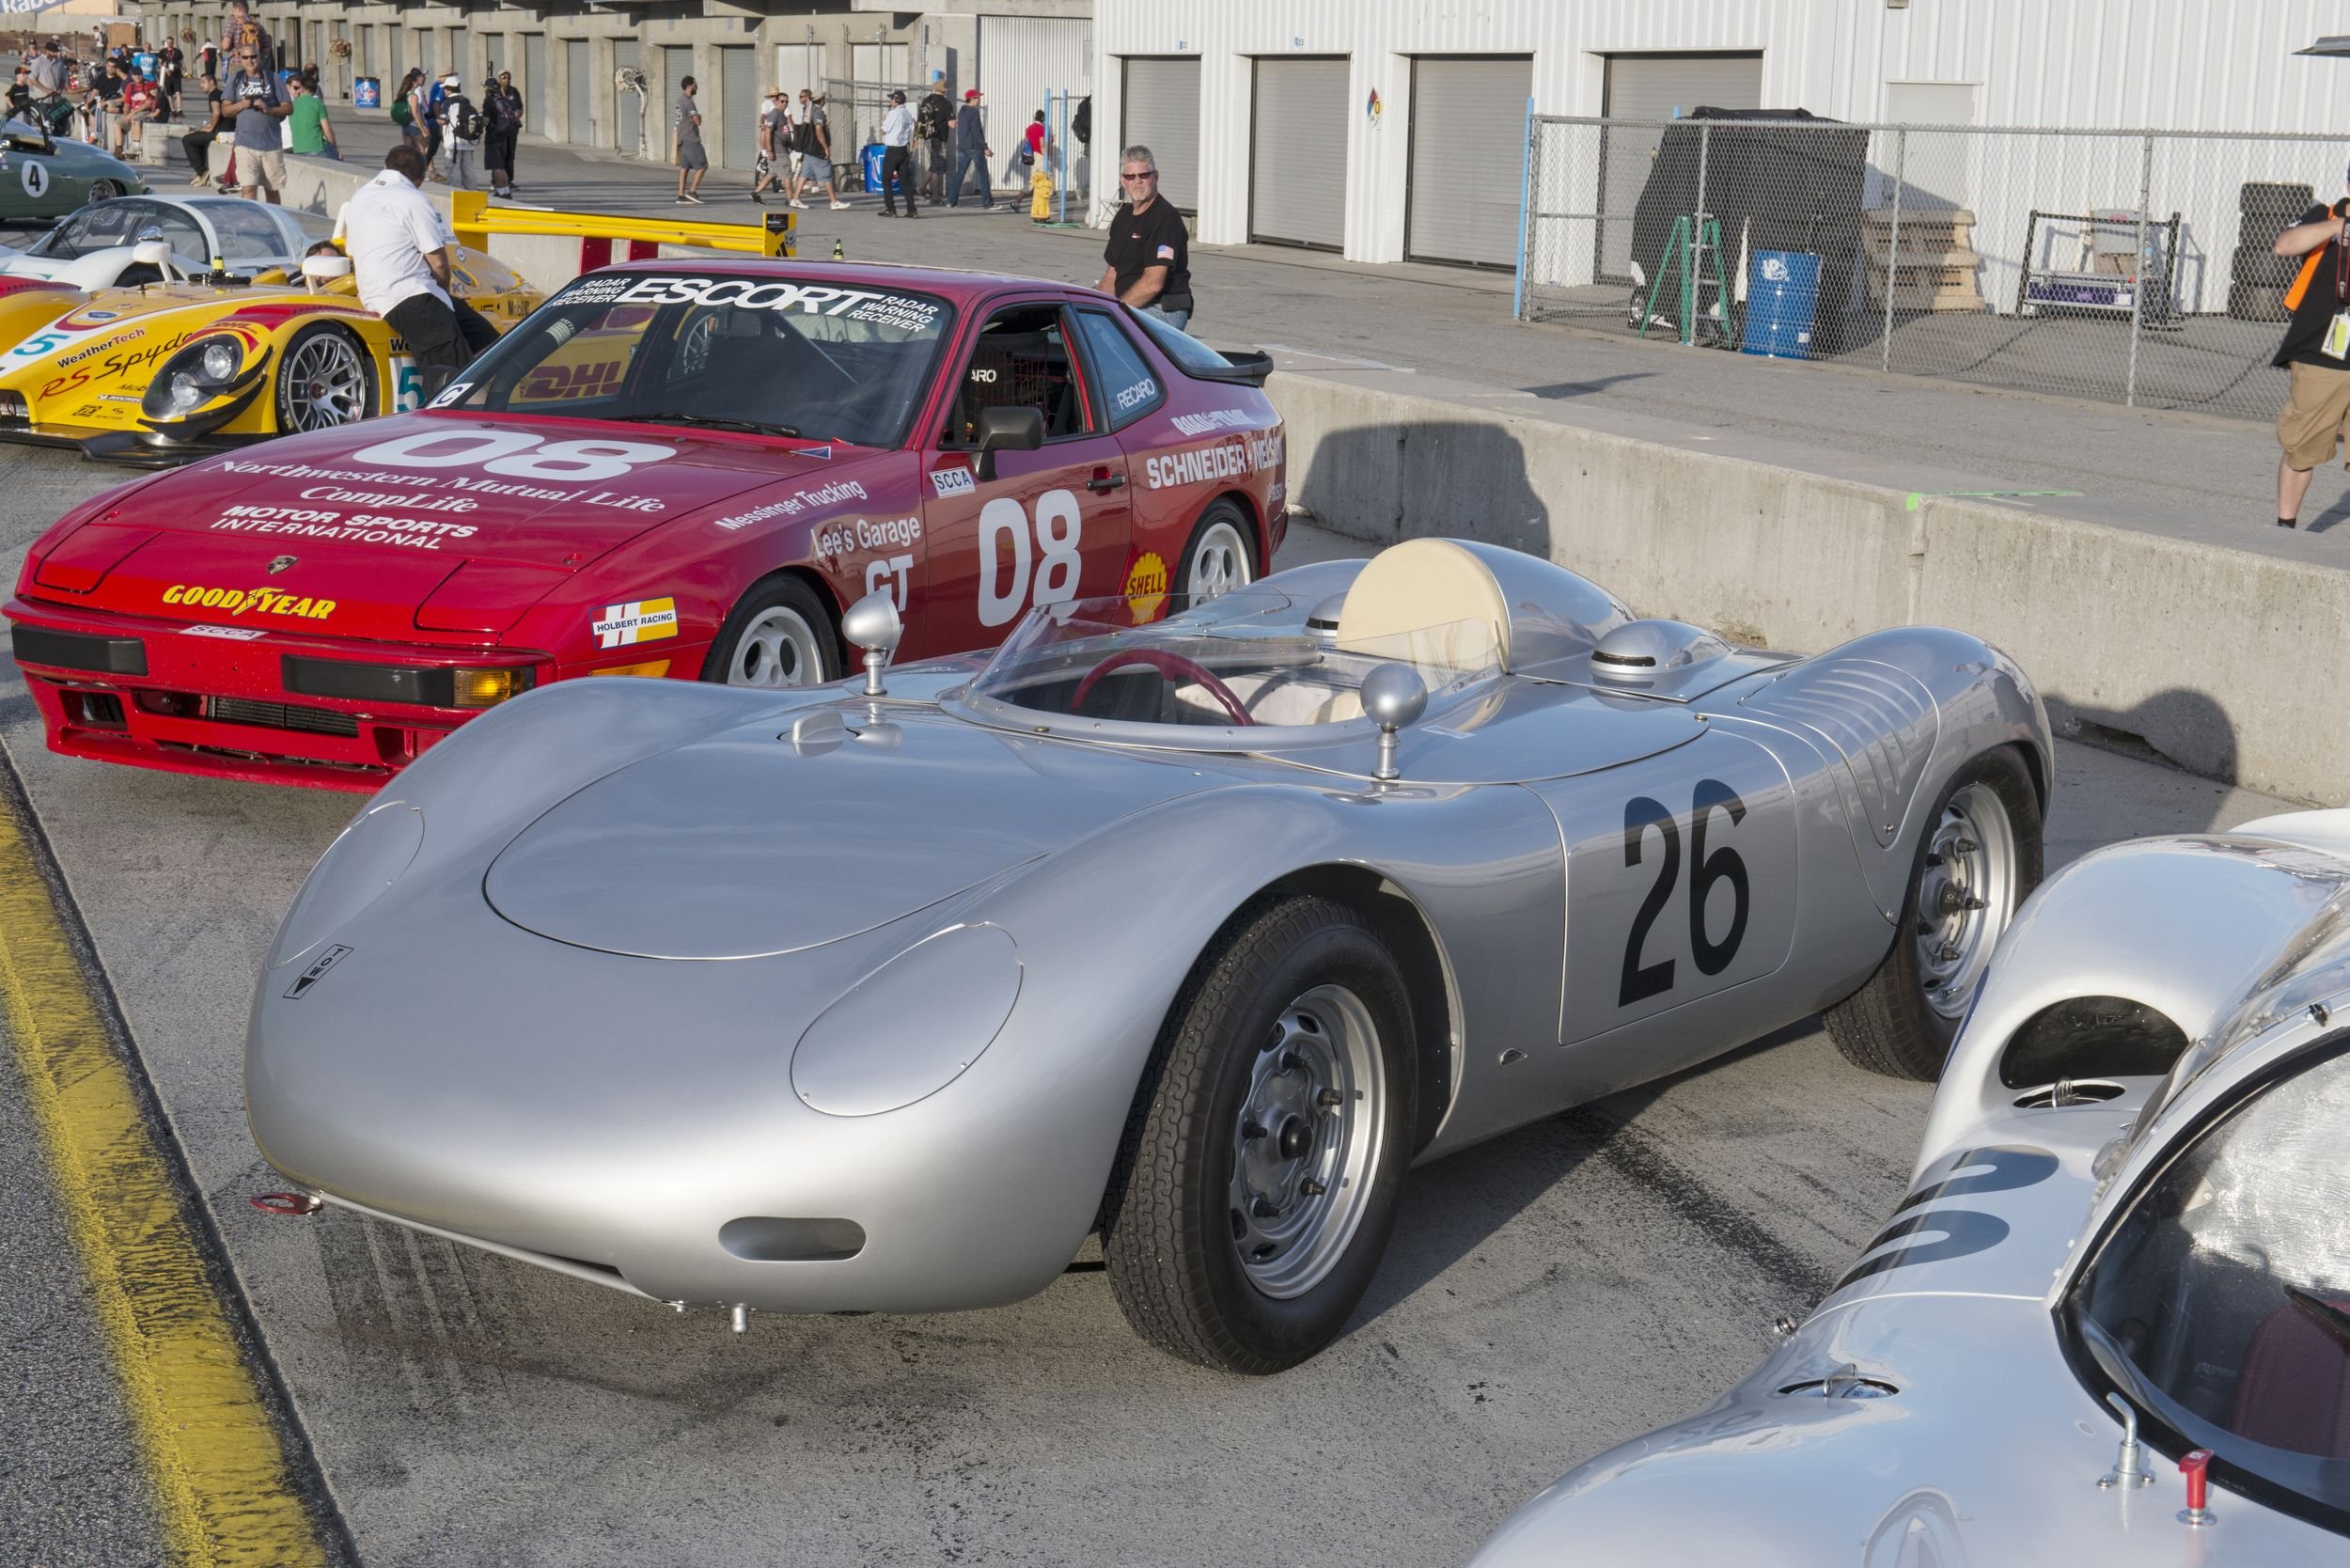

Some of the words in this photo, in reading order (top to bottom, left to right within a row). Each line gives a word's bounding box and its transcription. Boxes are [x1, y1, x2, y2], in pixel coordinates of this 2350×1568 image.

[28, 165, 40, 192] 4
[560, 286, 626, 299] WARNING
[580, 277, 632, 290] RADAR
[612, 277, 886, 317] ESCORT
[547, 294, 617, 308] RECEIVER
[860, 302, 933, 323] WARNING
[881, 296, 939, 315] RADAR
[846, 309, 926, 332] RECEIVER
[13, 333, 71, 356] 5
[56, 328, 146, 368] WeatherTech
[37, 366, 91, 402] RS
[398, 366, 426, 412] 5
[520, 361, 623, 400] DHL
[1116, 378, 1155, 412] RECARO
[352, 429, 678, 482] 08
[1146, 444, 1248, 490] SCHNEIDER
[201, 461, 438, 494] Northwestern
[435, 477, 589, 502] Mutual
[580, 491, 666, 512] Life
[934, 470, 972, 490] SCCA
[299, 486, 480, 513] CompLife
[714, 498, 802, 531] Messinger
[800, 478, 869, 509] Trucking
[209, 518, 444, 551] INTERNATIONAL
[220, 505, 341, 524] MOTOR
[343, 514, 479, 539] SPORTS
[810, 524, 854, 558] Lee's
[856, 516, 921, 549] Garage
[978, 489, 1082, 627] 08
[1128, 572, 1164, 603] SHELL
[192, 625, 258, 639] SCCA
[597, 618, 638, 632] HOLBERT
[640, 612, 673, 625] RACING
[1618, 778, 1750, 1009] 26
[308, 948, 345, 977] TOW
